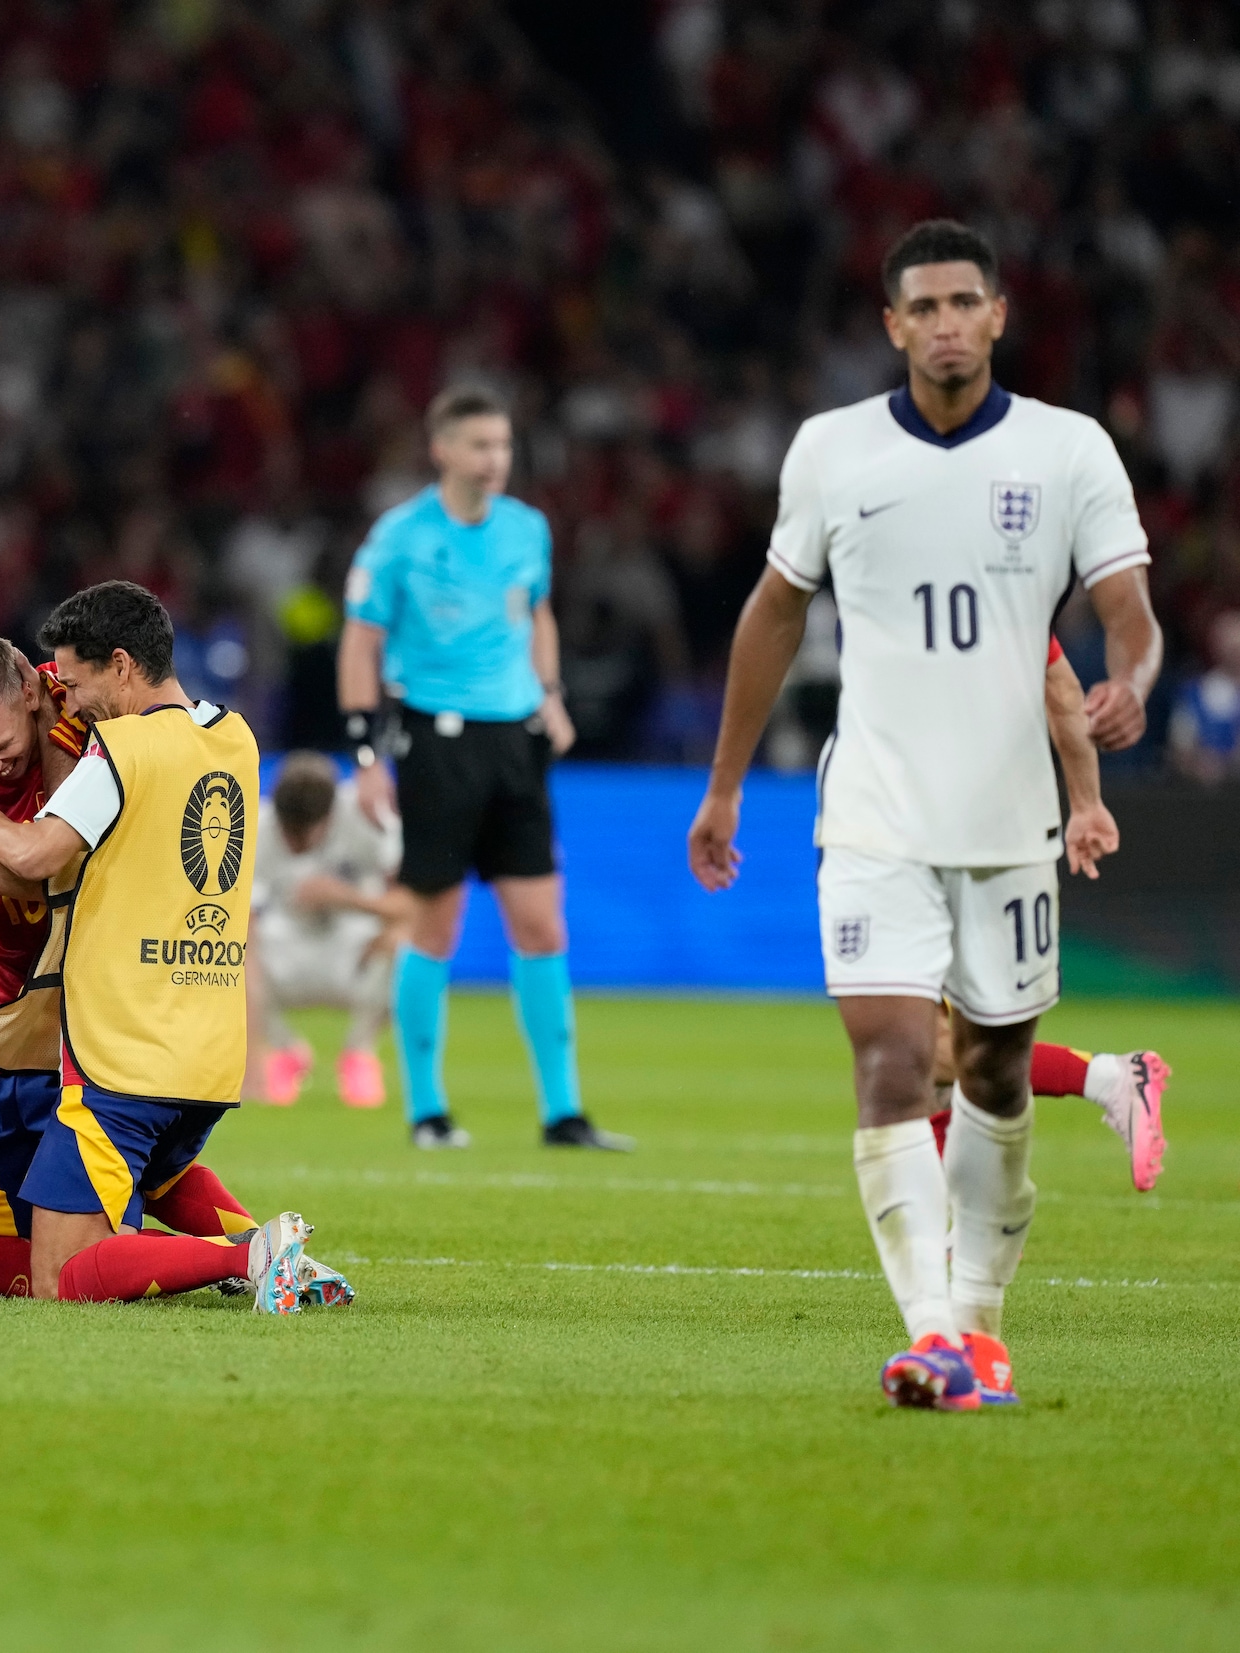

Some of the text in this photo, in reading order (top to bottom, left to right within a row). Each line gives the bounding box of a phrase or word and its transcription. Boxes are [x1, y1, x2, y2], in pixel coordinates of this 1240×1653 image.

[913, 583, 978, 652] 10
[186, 909, 227, 932] UEFA
[1004, 892, 1051, 962] 10
[140, 938, 247, 967] EURO20
[171, 971, 240, 987] GERMANY
